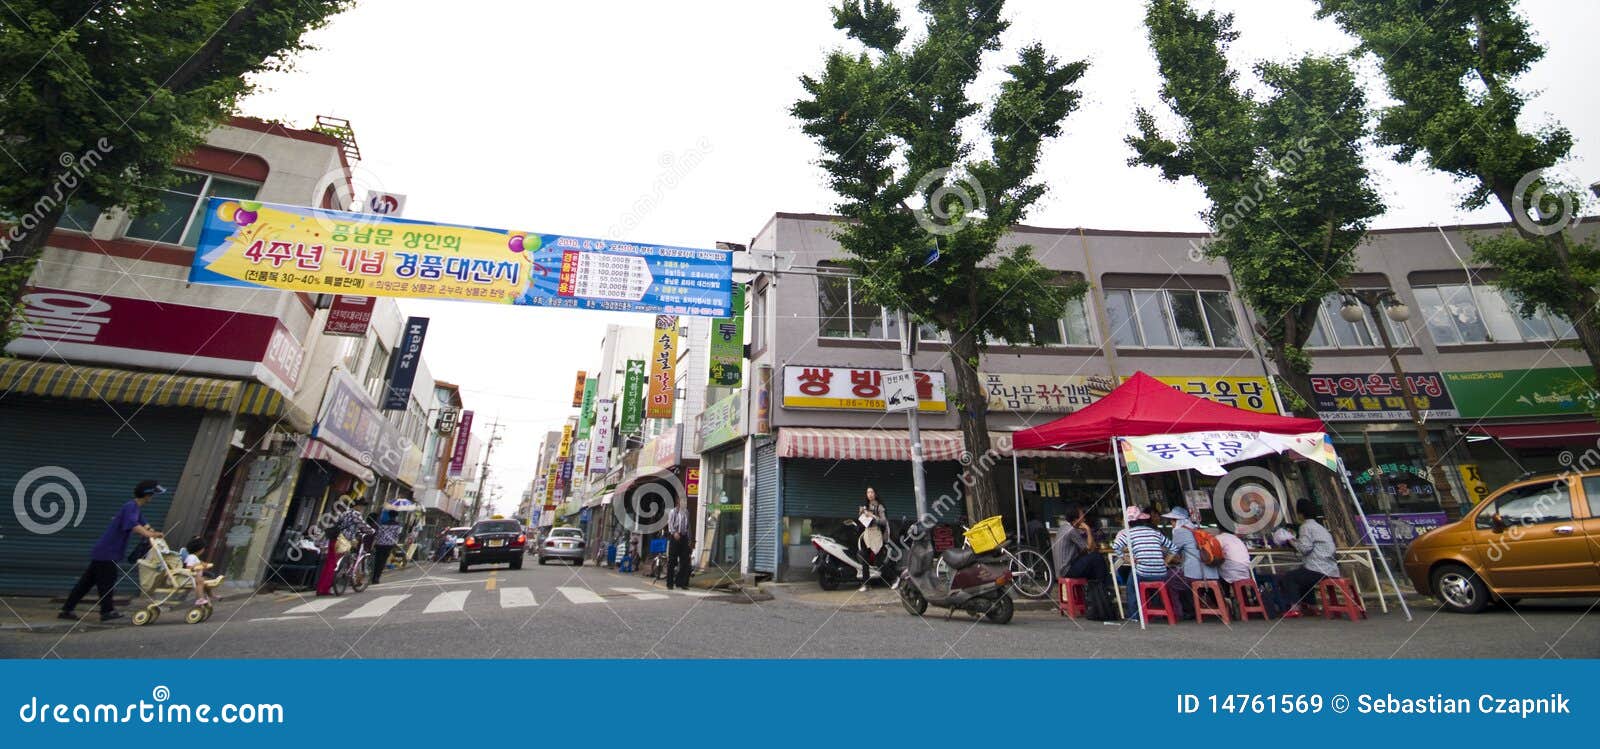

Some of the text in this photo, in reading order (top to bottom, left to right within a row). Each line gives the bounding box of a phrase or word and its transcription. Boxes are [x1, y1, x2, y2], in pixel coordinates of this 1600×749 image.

[331, 223, 462, 252] 풍남문 상인회
[244, 239, 520, 284] 4주년 기념 경품대잔치
[400, 324, 422, 369] Haatz
[1311, 374, 1443, 398] 라이온미싱
[441, 412, 457, 433] 다방
